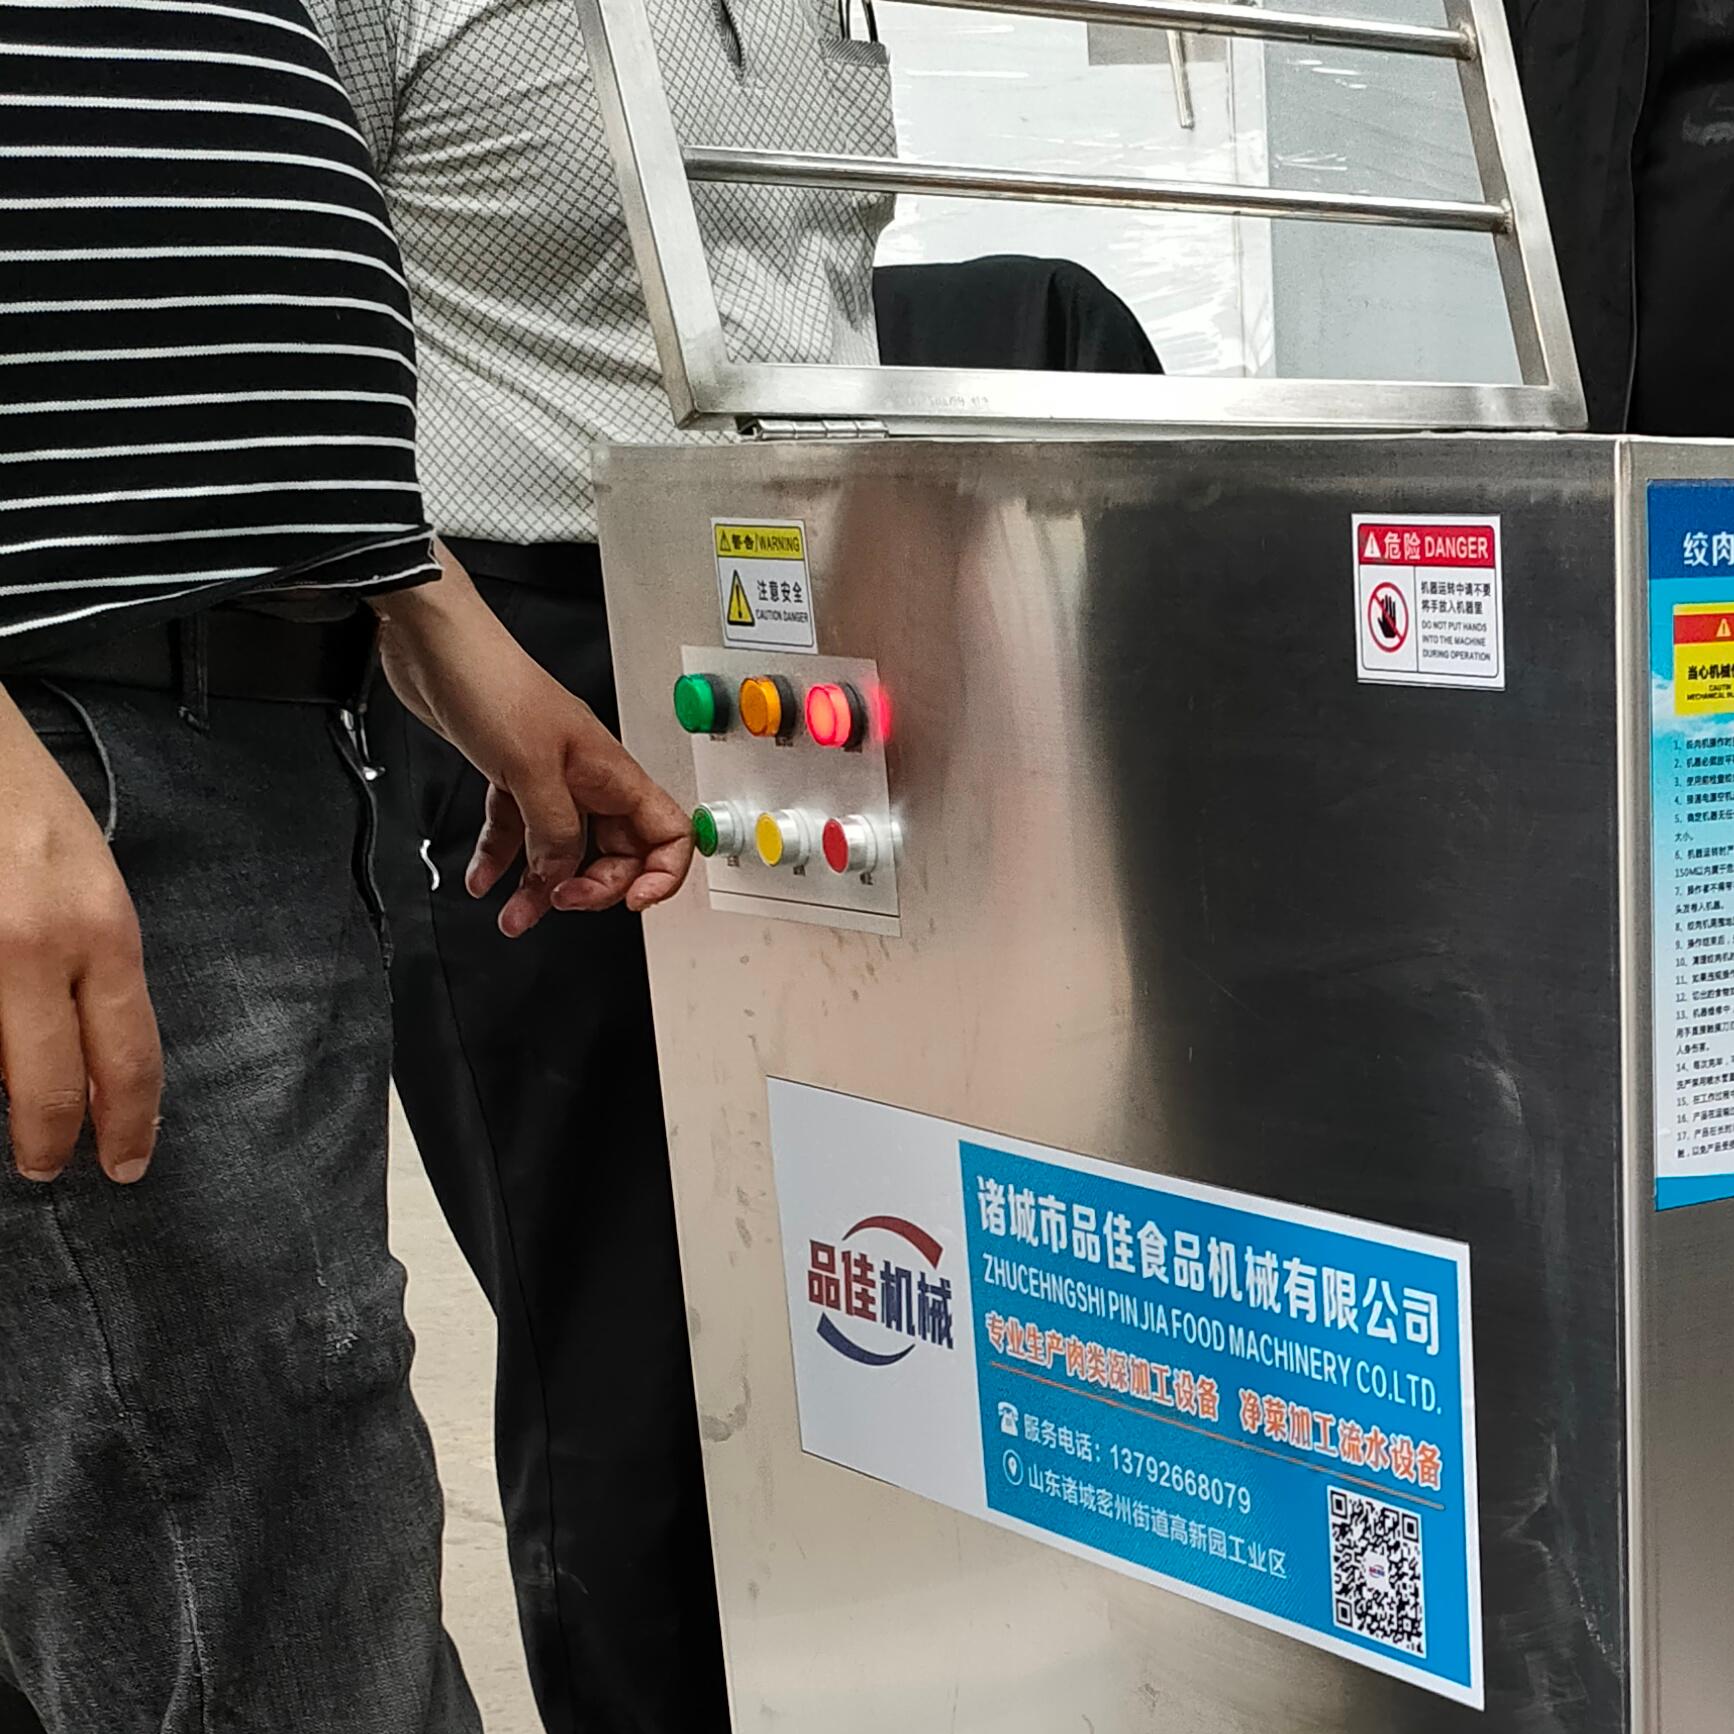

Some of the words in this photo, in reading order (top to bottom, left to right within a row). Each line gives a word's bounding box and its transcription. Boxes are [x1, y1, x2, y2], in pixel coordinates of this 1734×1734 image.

[757, 579, 804, 604] 注意安全
[758, 534, 800, 552] WARNING
[1384, 531, 1421, 560] 危险
[1424, 535, 1489, 560] DANGER
[807, 1238, 955, 1349] 品佳机械
[976, 1175, 1440, 1356] 诸城市品佳食品机械有限公司
[982, 1252, 1106, 1318] ZHUCEHNGSHI
[1171, 1308, 1225, 1353] FOOD
[1229, 1324, 1352, 1387] MACHINERY
[1356, 1360, 1442, 1415] CO.LTD.
[985, 1311, 1220, 1422] 专业生产肉类深加工设备
[1239, 1387, 1443, 1491] 净菜加工流水设备
[1028, 1463, 1287, 1579] 山东诸城密州街道高新园工业区
